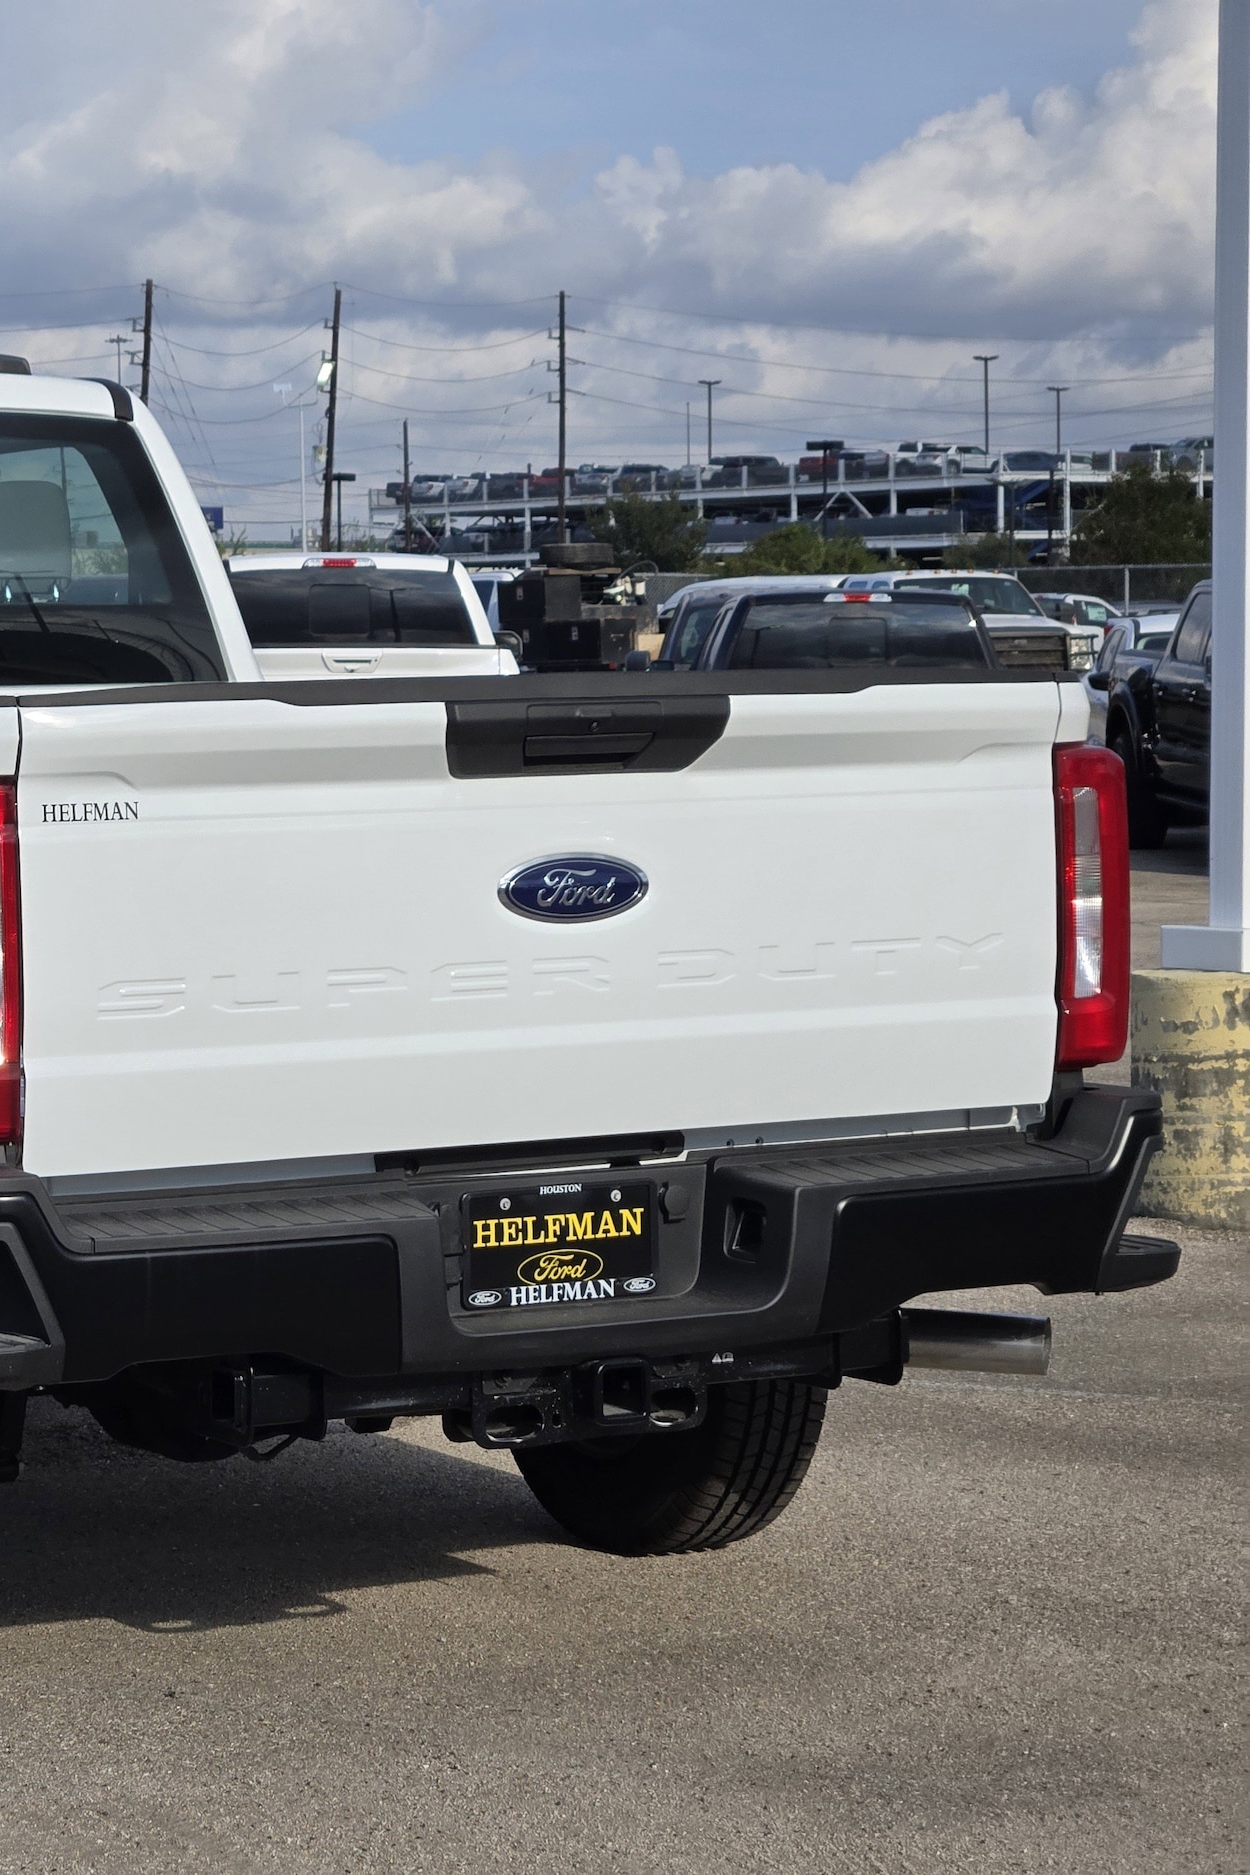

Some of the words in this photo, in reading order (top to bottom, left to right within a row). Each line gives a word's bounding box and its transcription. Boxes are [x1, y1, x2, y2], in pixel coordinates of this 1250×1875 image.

[41, 800, 140, 824] HELFMAN
[536, 868, 616, 908] Ford
[97, 955, 610, 1021] SUPER
[656, 932, 1005, 989] DUTY
[539, 1183, 583, 1196] HOUSTON
[472, 1207, 645, 1248] HELFMAN
[533, 1253, 588, 1281] Ford
[509, 1278, 617, 1307] HELFMAN
[629, 1278, 651, 1290] Ford
[474, 1293, 497, 1304] Ford
